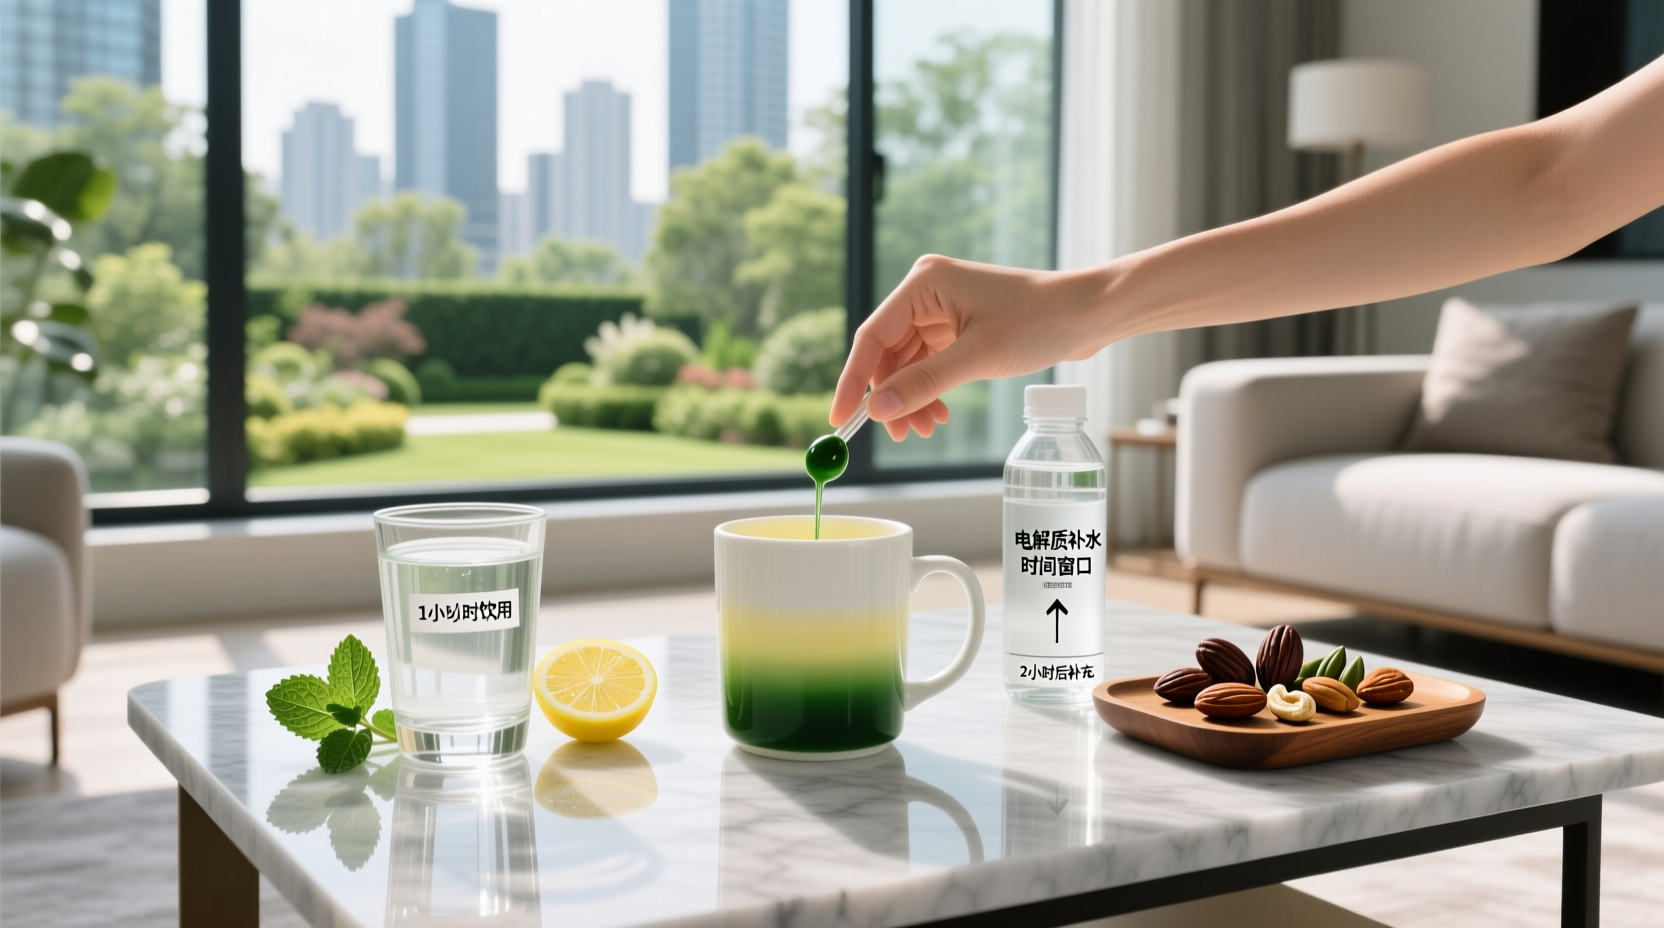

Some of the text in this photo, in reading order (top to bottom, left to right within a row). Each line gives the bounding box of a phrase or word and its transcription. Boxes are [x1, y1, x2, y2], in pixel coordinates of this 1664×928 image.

[1015, 529, 1102, 551] 电解质补水
[1021, 556, 1092, 576] 时间窗口
[1019, 663, 1095, 681] 2小时后补充
